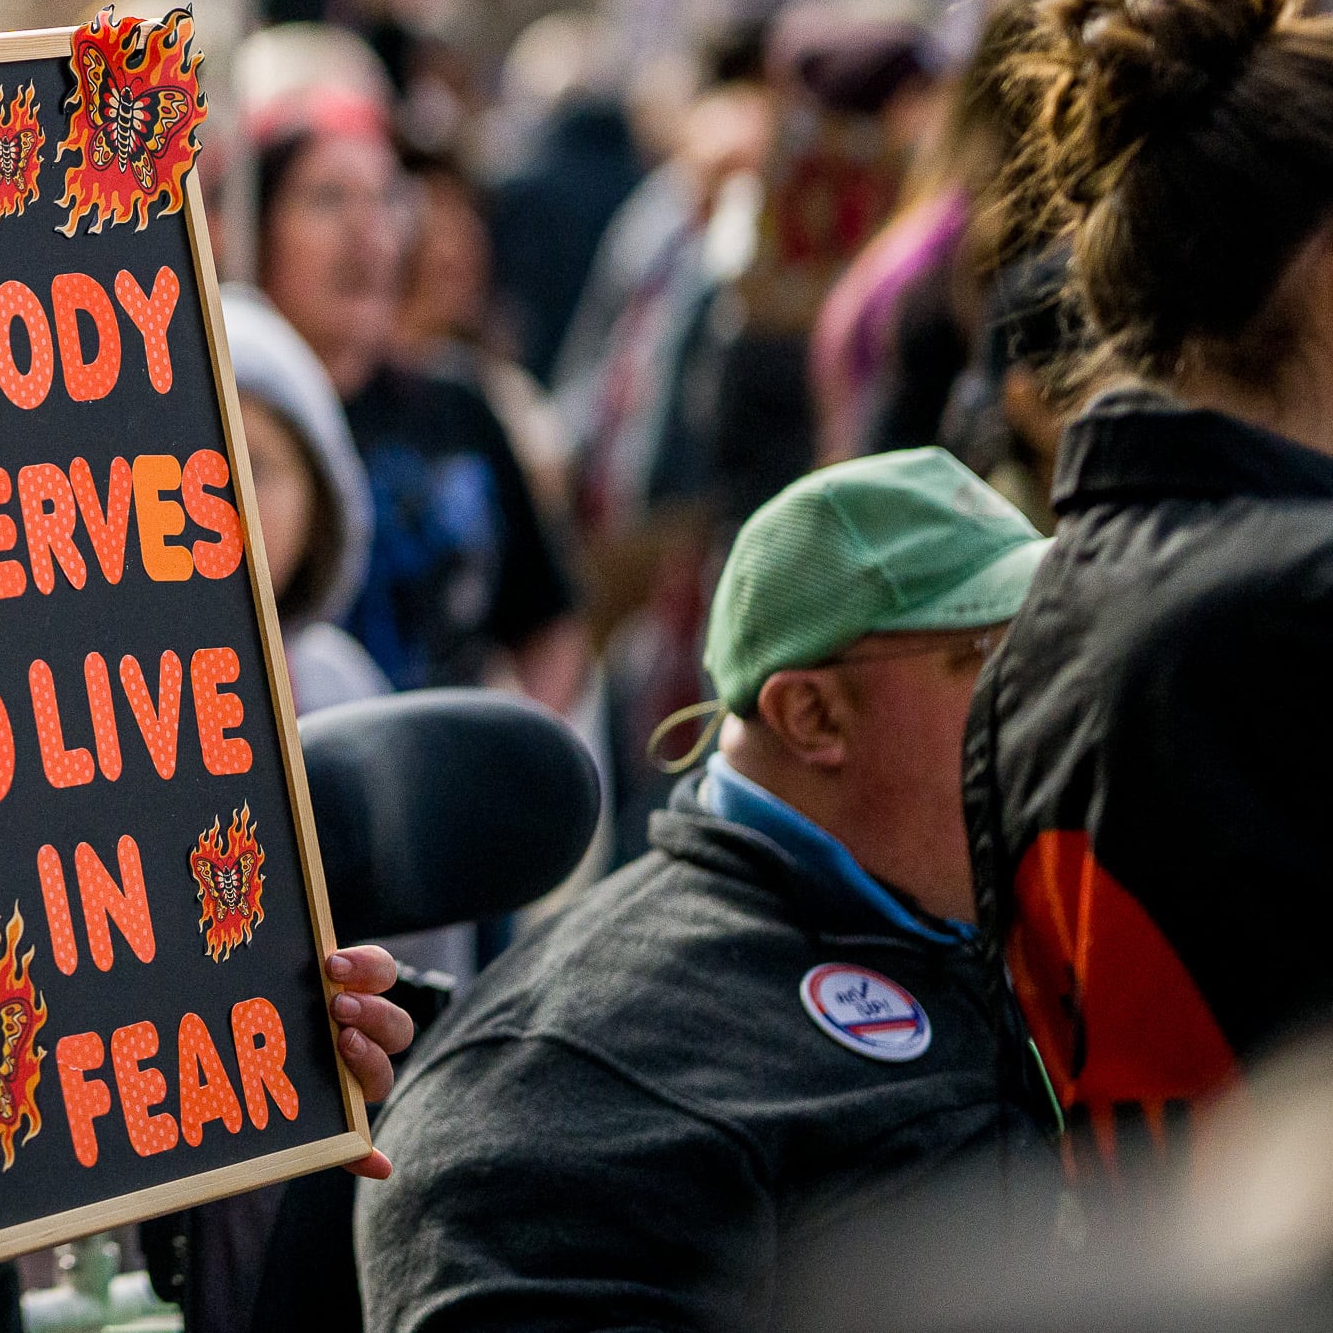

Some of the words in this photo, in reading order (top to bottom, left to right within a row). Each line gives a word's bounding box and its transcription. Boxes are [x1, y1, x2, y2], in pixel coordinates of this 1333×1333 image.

[28, 647, 253, 789] LIVE
[37, 834, 156, 976] IN
[55, 996, 299, 1168] FEAR
